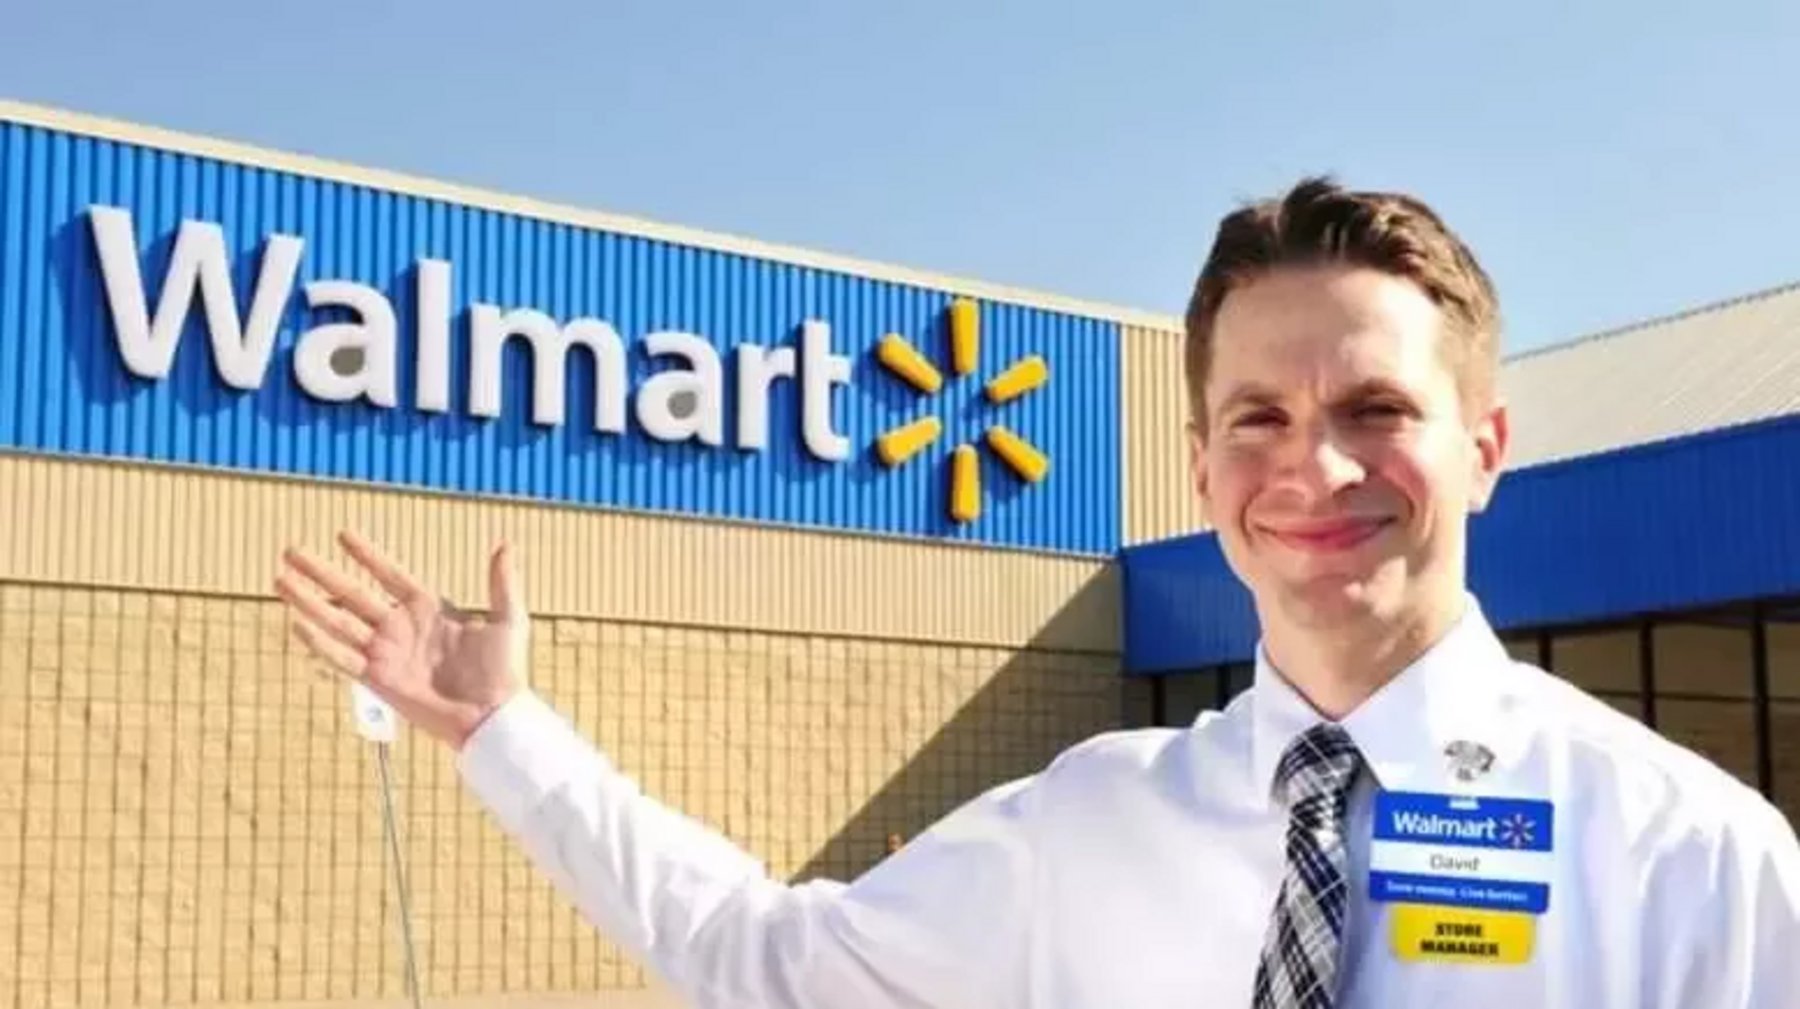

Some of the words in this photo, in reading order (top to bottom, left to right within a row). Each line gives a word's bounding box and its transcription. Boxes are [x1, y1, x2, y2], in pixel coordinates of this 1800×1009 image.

[88, 204, 851, 461] Walmart
[1392, 811, 1497, 840] Walmart
[1429, 853, 1480, 871] David
[1434, 923, 1483, 937] STORE
[1420, 940, 1499, 956] MANAGER
